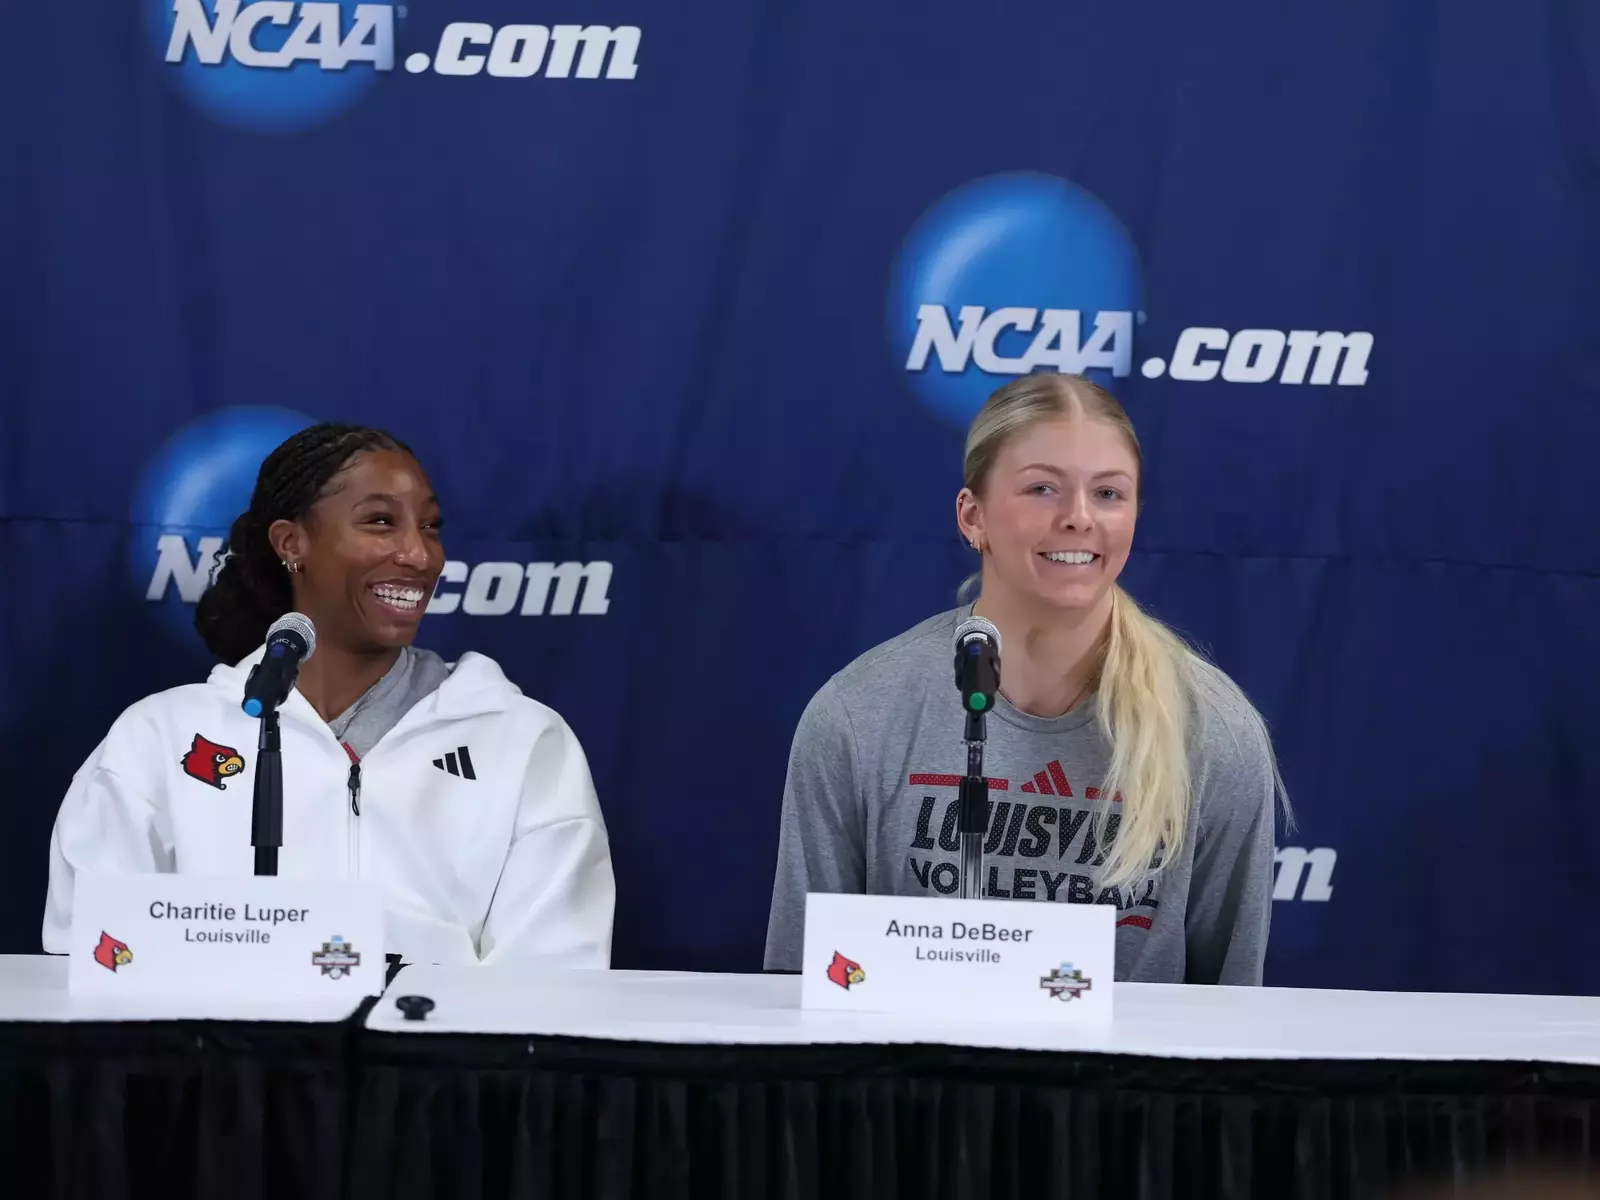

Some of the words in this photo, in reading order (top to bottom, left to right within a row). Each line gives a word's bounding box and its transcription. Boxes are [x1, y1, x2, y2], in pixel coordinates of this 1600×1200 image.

[425, 560, 613, 615] com
[149, 900, 237, 921] Charitie
[244, 903, 310, 926] Luper
[185, 927, 271, 944] Louisville
[885, 919, 943, 939] Anna
[951, 921, 1033, 943] DeBeer
[915, 946, 1001, 964] Louisville
